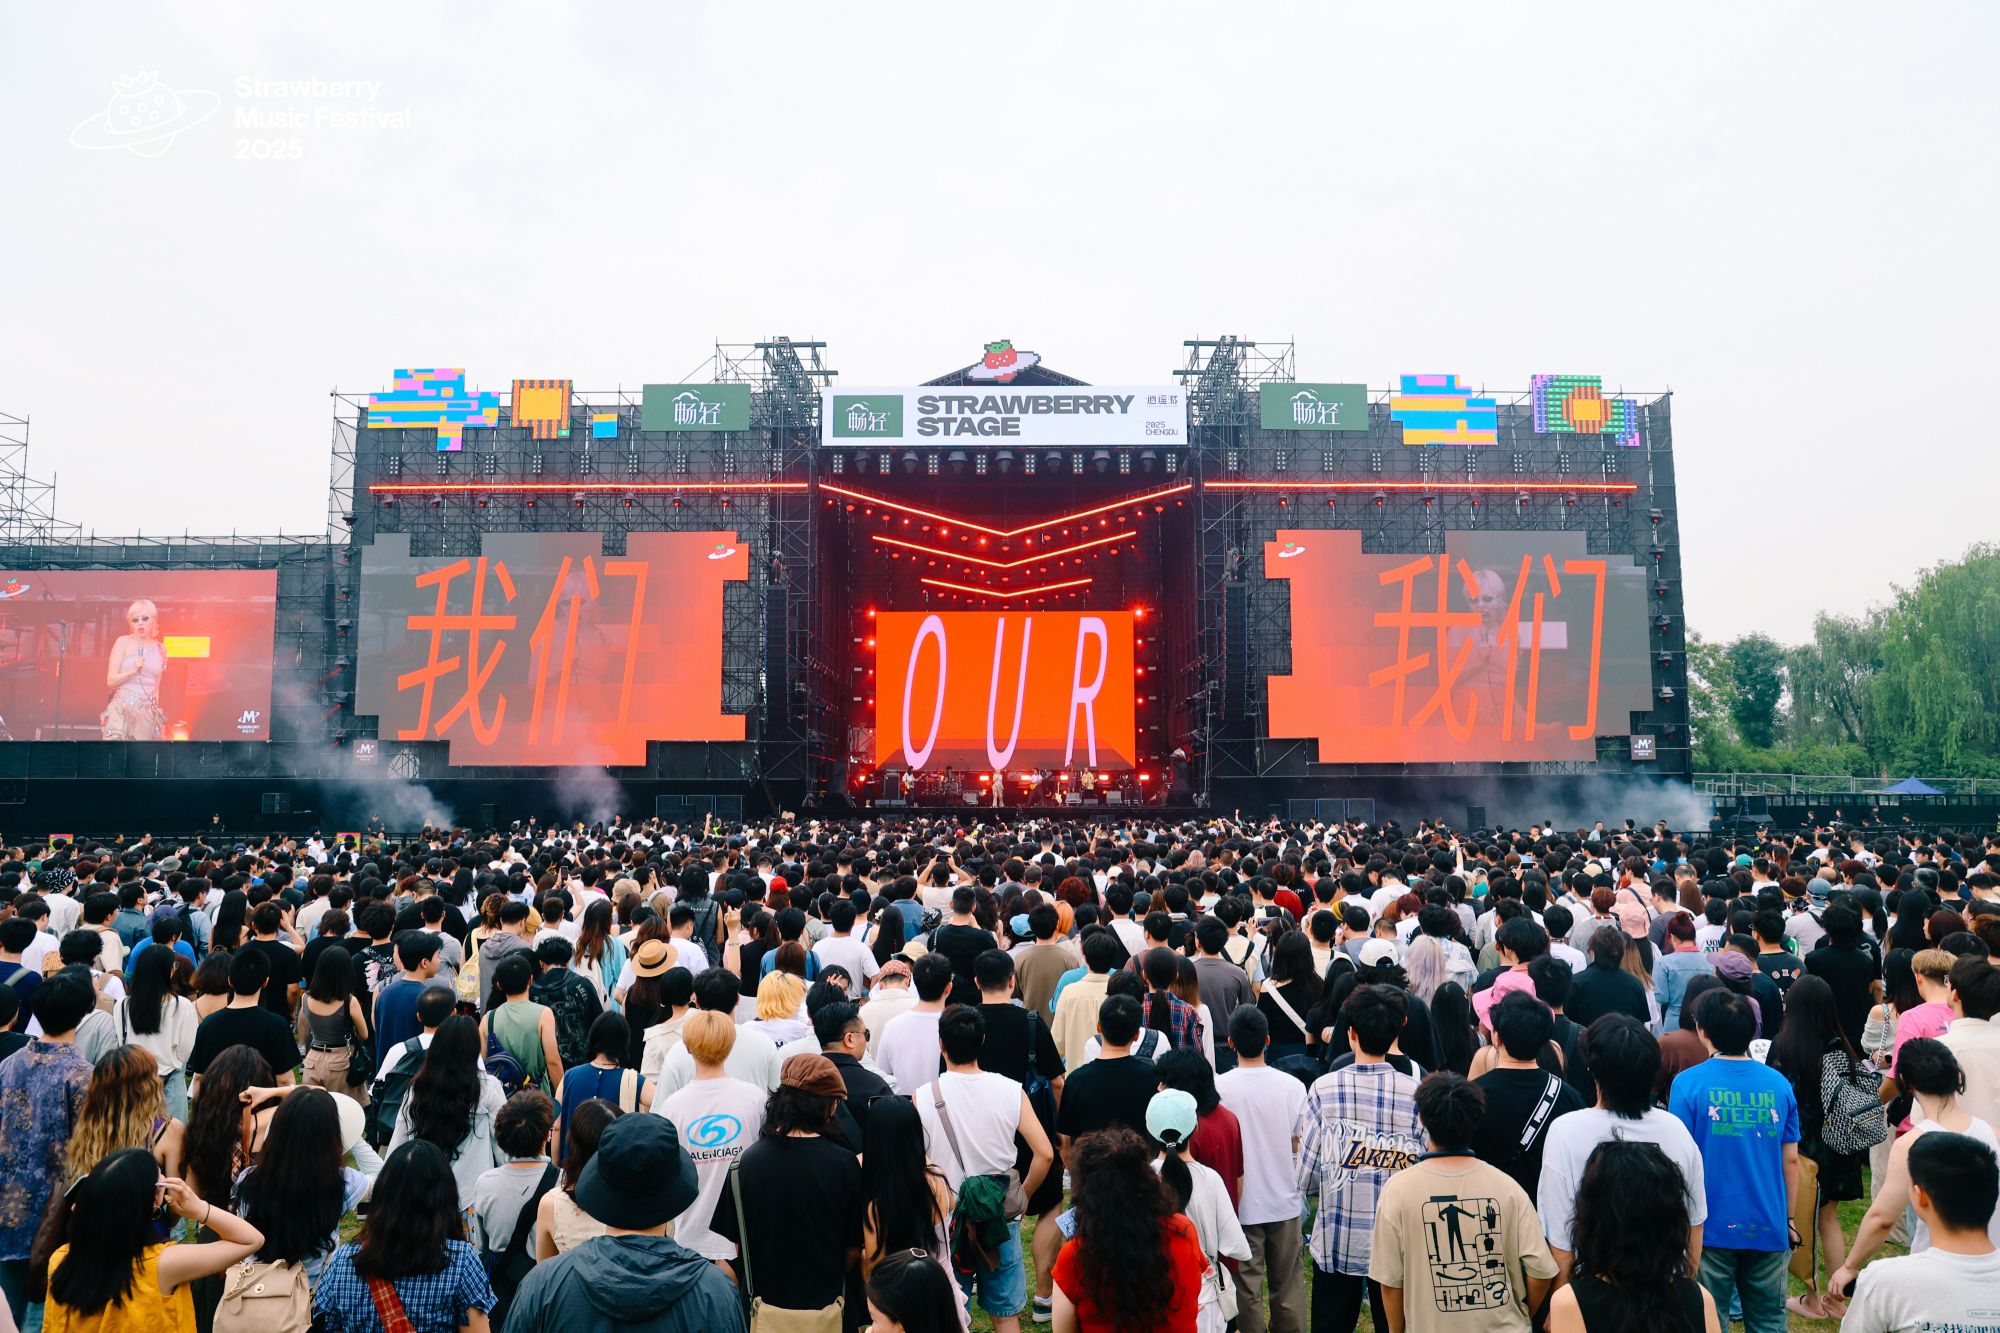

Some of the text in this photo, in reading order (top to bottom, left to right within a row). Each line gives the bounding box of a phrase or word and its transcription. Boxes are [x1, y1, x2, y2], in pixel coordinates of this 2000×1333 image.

[674, 401, 722, 425] 畅轻
[916, 395, 1135, 415] STRAWBERRY
[1293, 400, 1341, 425] 畅轻
[848, 411, 888, 431] 畅轻
[916, 416, 1020, 437] STAGE
[1145, 421, 1166, 429] 2025
[1145, 428, 1179, 436] CHENGDU
[398, 554, 648, 746] 我们
[1368, 554, 1606, 742] 我们
[690, 1146, 744, 1161] ALENCIAGA
[1340, 1140, 1418, 1170] LAKERS
